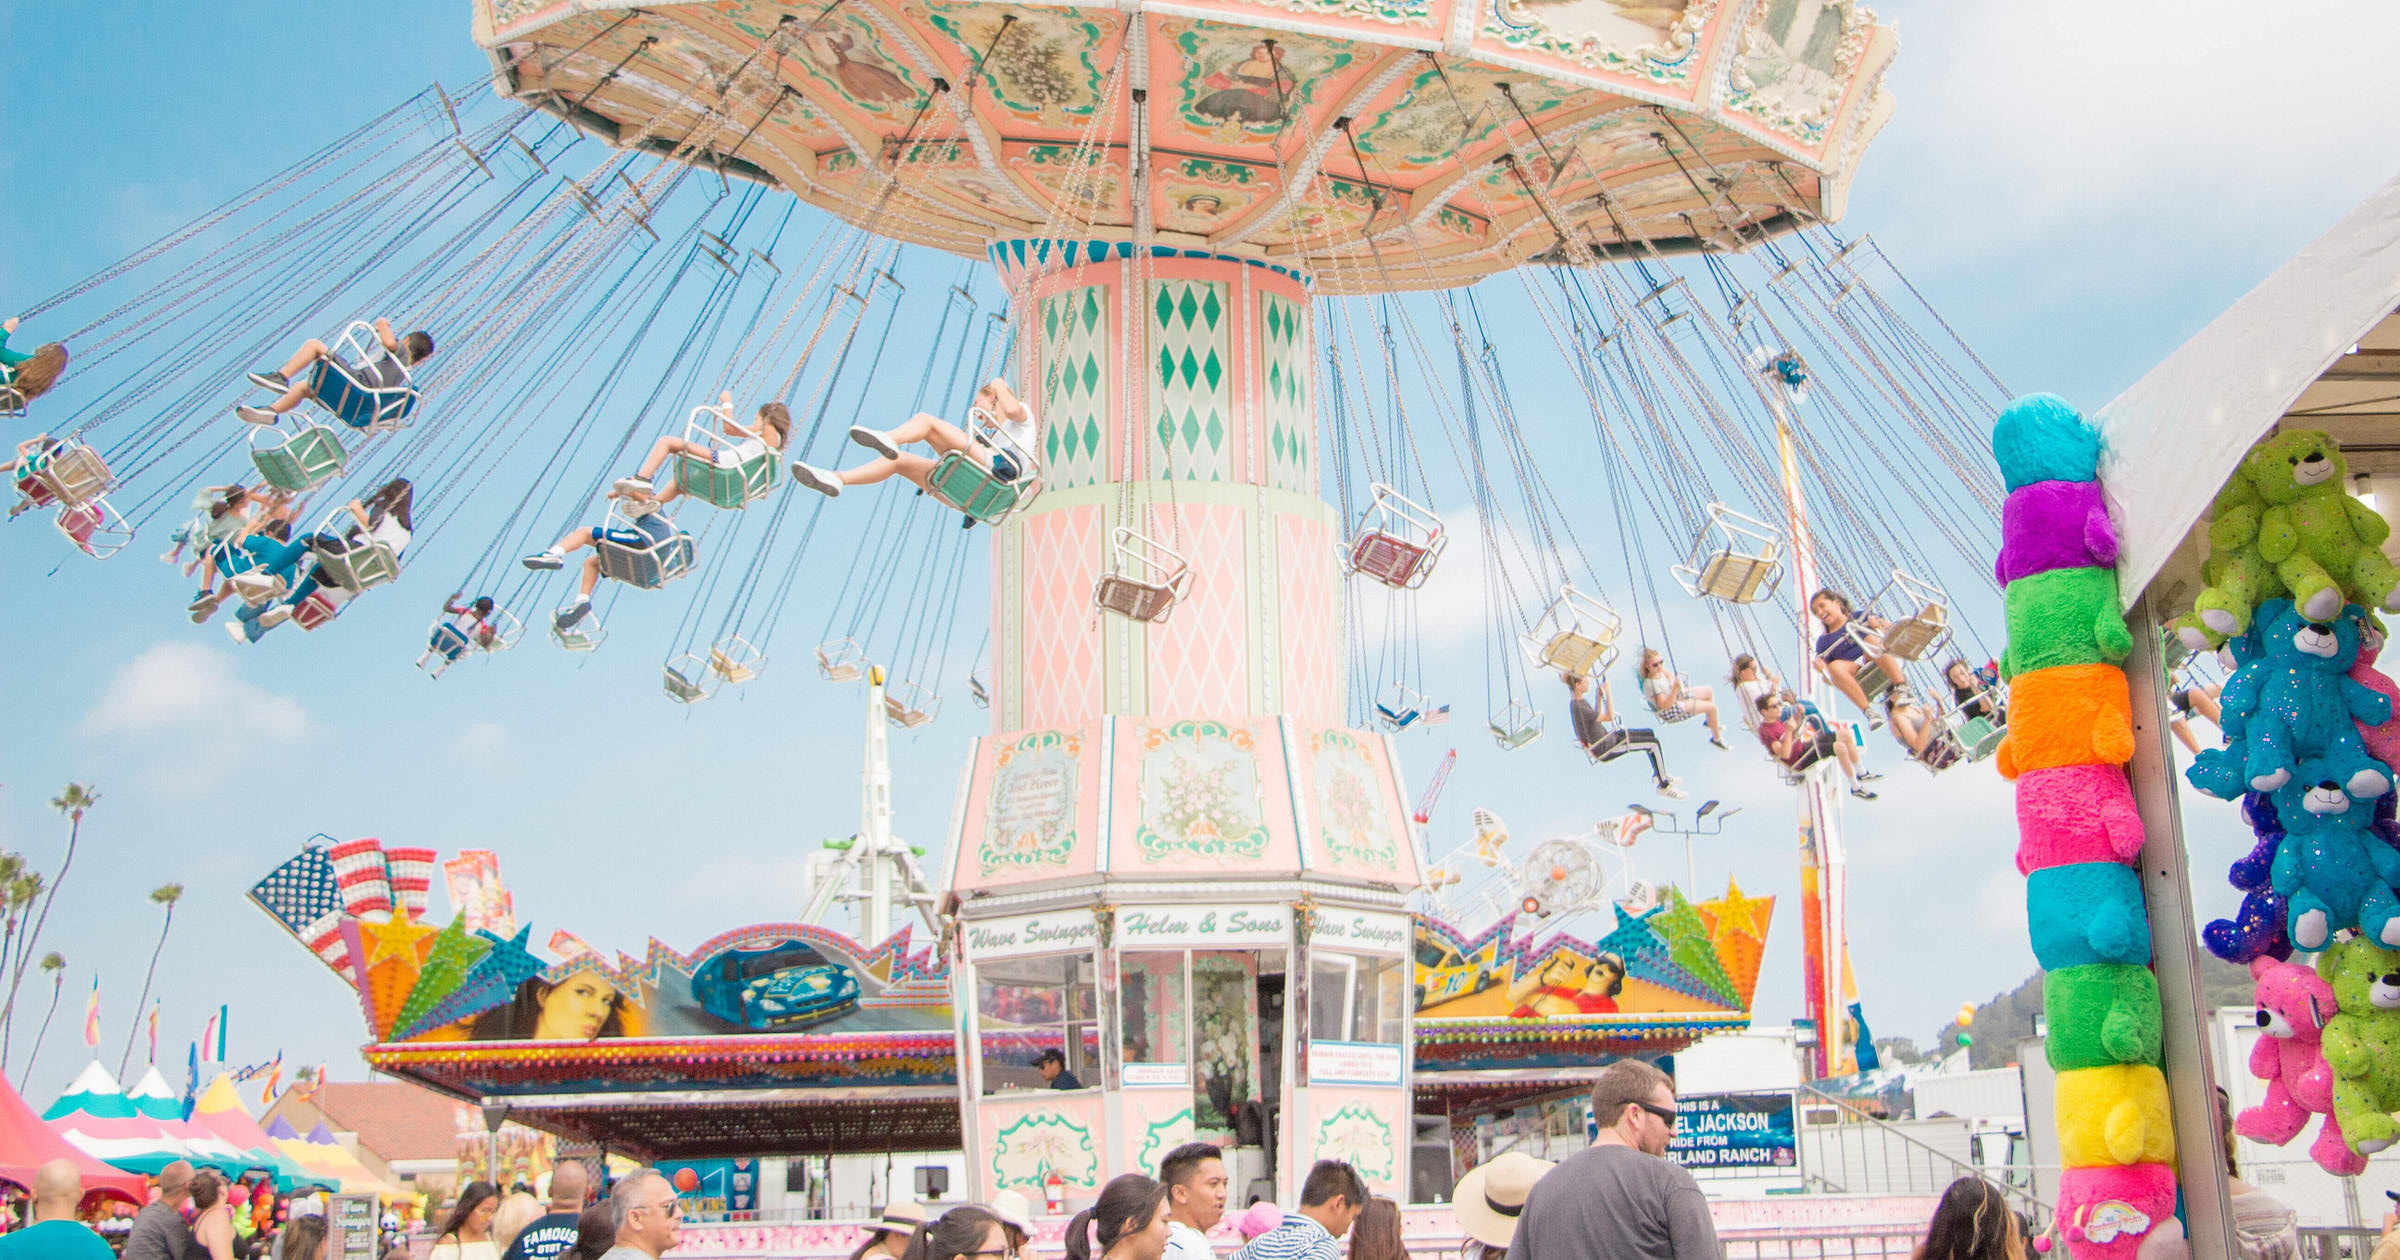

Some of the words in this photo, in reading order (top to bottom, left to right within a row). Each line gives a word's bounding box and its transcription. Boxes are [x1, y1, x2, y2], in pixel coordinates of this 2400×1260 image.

[1123, 911, 1190, 935] Helm
[1199, 910, 1217, 933] &
[1226, 911, 1283, 933] Sons
[1314, 914, 1345, 937] Wave
[1350, 918, 1404, 948] Swinger
[969, 927, 1016, 949] Wave
[1023, 921, 1097, 945] Swinger
[1675, 1101, 1697, 1113] THIS
[1698, 1100, 1710, 1112] IS
[1711, 1099, 1720, 1110] A
[1696, 1112, 1769, 1133] JACKSON
[1670, 1137, 1695, 1148] RIDE
[1696, 1136, 1728, 1146] FROM
[1663, 1150, 1716, 1164] RLAND
[1719, 1147, 1770, 1163] RANCH
[523, 1227, 579, 1249] FAMOUS
